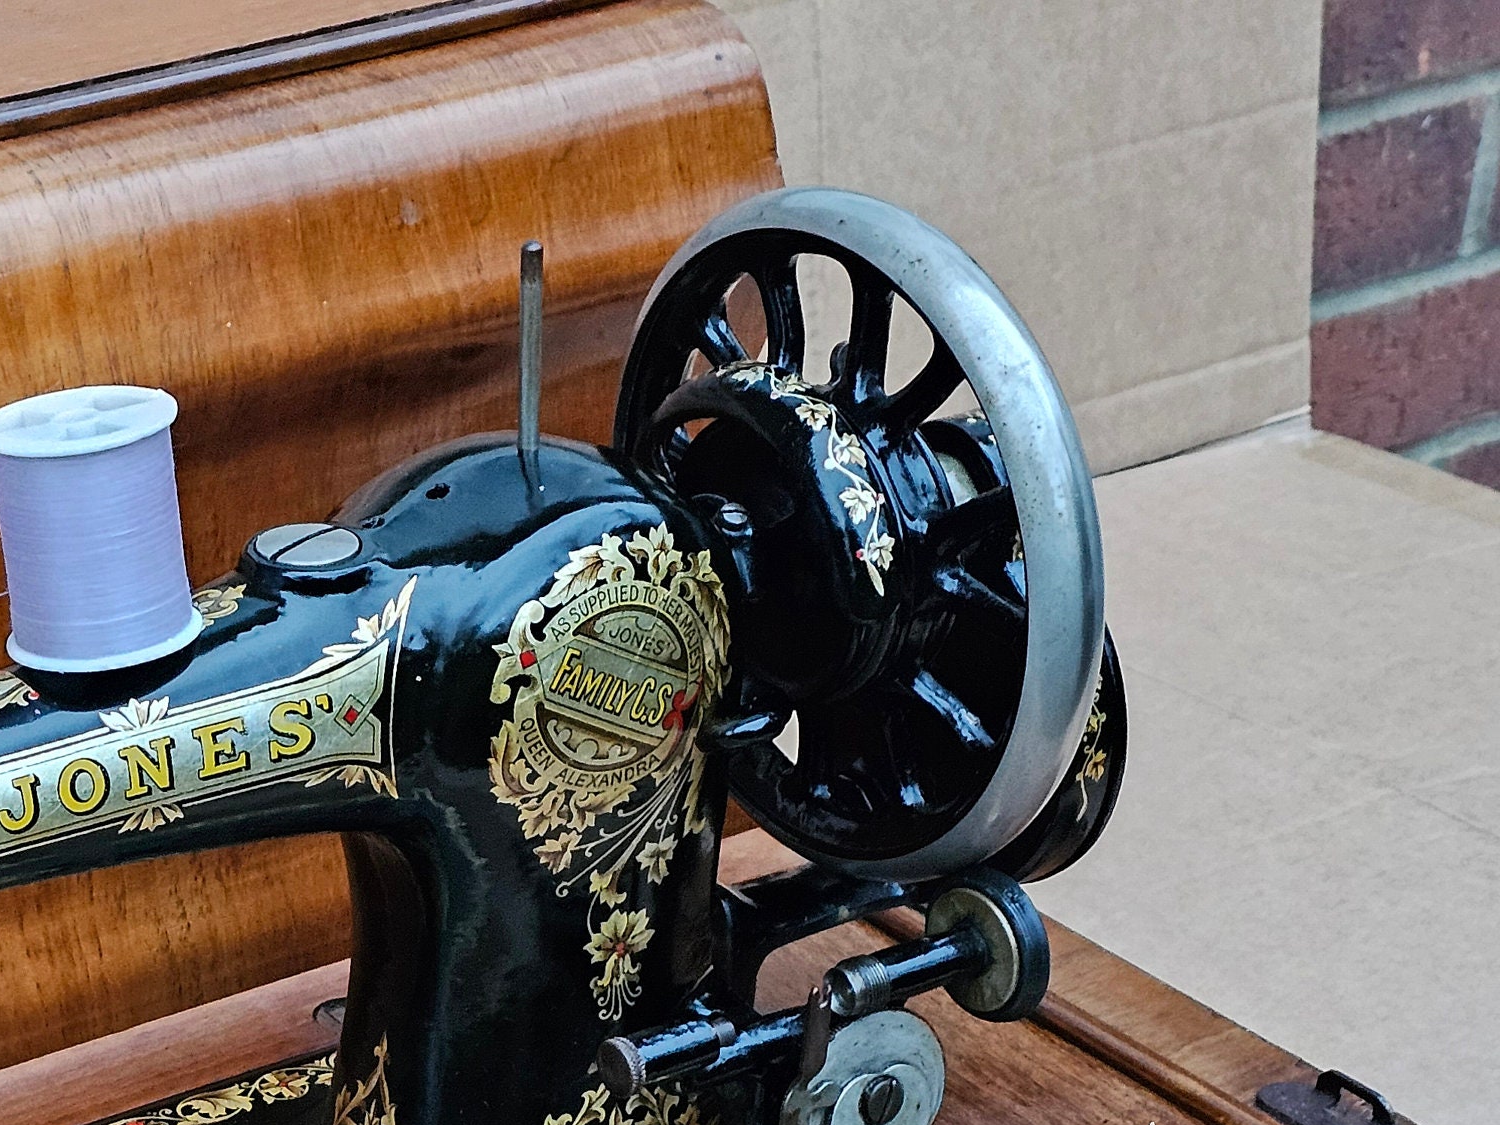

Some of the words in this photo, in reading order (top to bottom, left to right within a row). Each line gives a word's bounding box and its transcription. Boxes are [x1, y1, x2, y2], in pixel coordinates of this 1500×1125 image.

[551, 617, 573, 642] AS
[570, 585, 639, 622] SUPPLIED
[641, 585, 659, 604] TO
[660, 594, 683, 625] HER
[550, 647, 638, 716] FAMILY
[520, 718, 554, 772] QUEEN
[555, 754, 661, 789] ALEXANDRA
